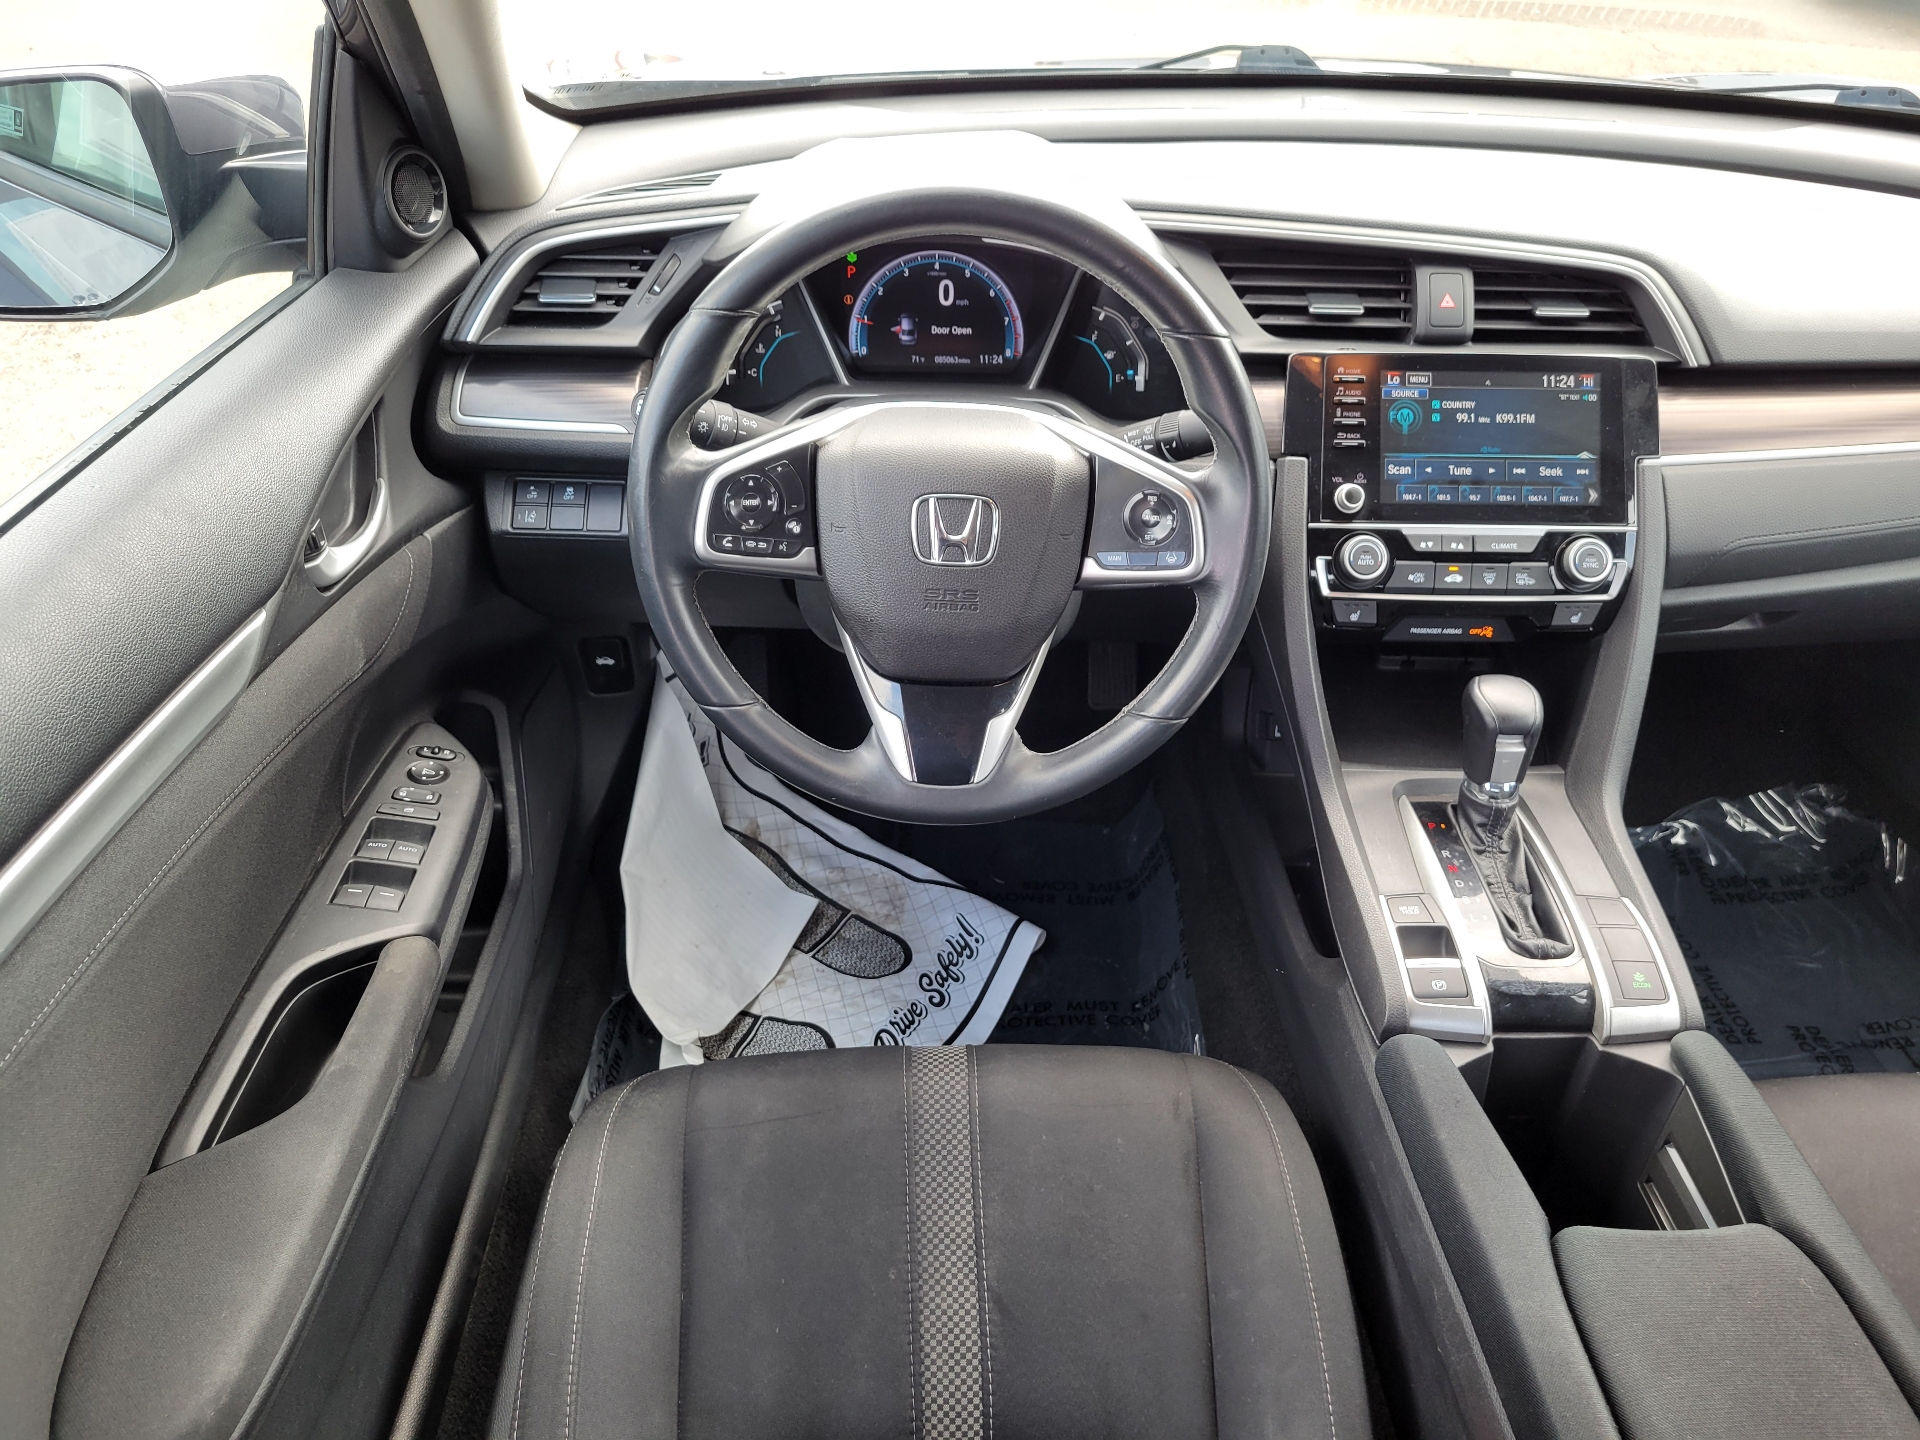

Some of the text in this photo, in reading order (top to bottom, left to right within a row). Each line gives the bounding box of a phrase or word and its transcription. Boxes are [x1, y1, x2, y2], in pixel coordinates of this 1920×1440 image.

[847, 265, 856, 278] P
[938, 279, 955, 307] 0
[931, 325, 973, 336] Door Open
[979, 354, 1003, 364] 11:24
[1387, 373, 1428, 385] Lo MENU
[1541, 374, 1575, 388] 11:24
[1583, 377, 1594, 387] Hi
[1391, 390, 1419, 398] SOURCE
[1441, 400, 1476, 409] COUNTRY
[720, 414, 733, 423] OFF
[1456, 412, 1475, 423] 99.1
[1496, 413, 1536, 424] K99.1FM
[1142, 433, 1154, 441] PULL
[1387, 463, 1412, 475] Scan
[1448, 464, 1473, 476] Tune
[1539, 465, 1564, 477] Seek
[741, 499, 759, 507] ENTER
[1491, 542, 1518, 550] CLIMATE
[1582, 561, 1599, 569] SYNC
[923, 588, 980, 600] SRS
[923, 601, 980, 612] AIRBAG
[1442, 627, 1463, 635] AIRBAG
[398, 845, 418, 853] AUTO
[1441, 850, 1452, 858] R
[1447, 864, 1459, 873] N
[1455, 880, 1465, 888] D
[918, 913, 984, 1009] Safely!
[1632, 981, 1651, 989] ECON
[1066, 1000, 1119, 1011] MUST
[998, 1013, 1097, 1030] ROTECTIVE
